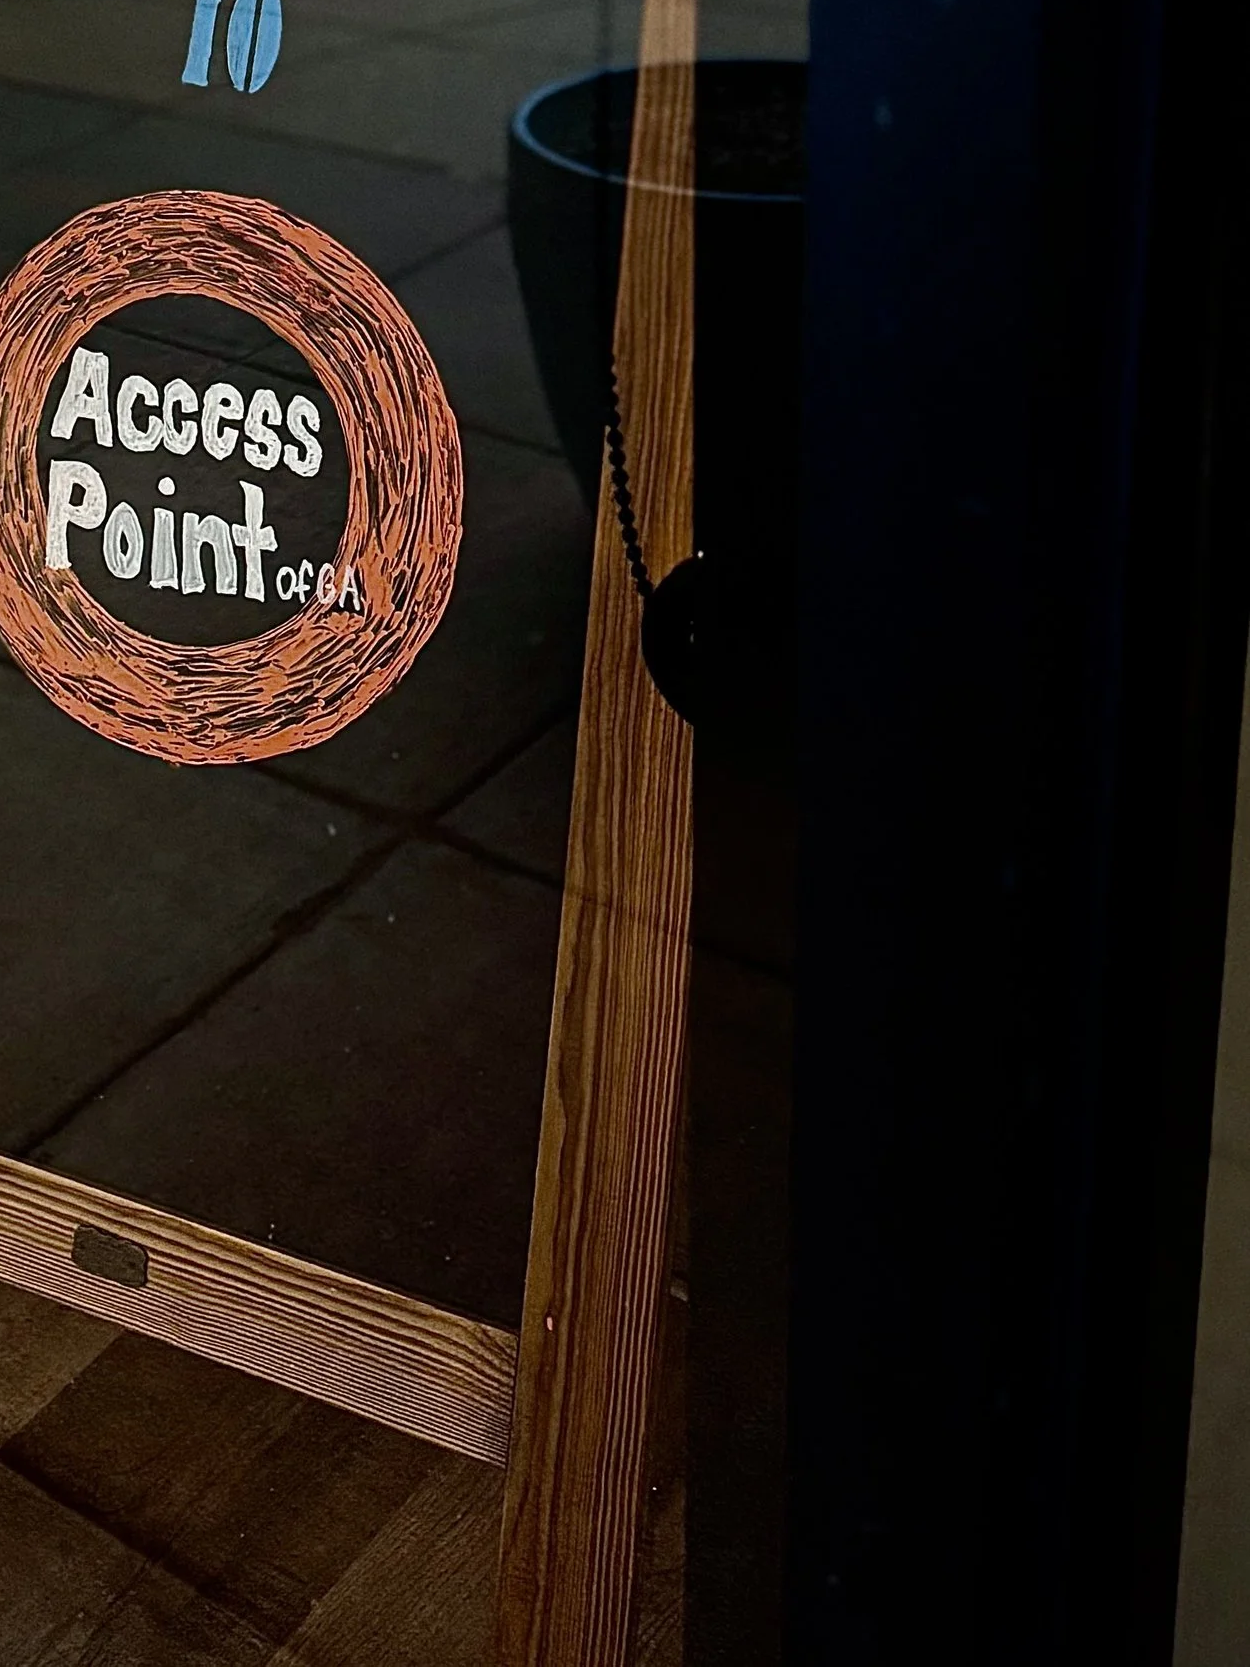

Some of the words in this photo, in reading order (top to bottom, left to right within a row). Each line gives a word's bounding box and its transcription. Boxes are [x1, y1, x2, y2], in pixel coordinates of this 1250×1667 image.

[51, 346, 323, 477] Access
[46, 460, 278, 603] Point
[316, 562, 361, 611] GA
